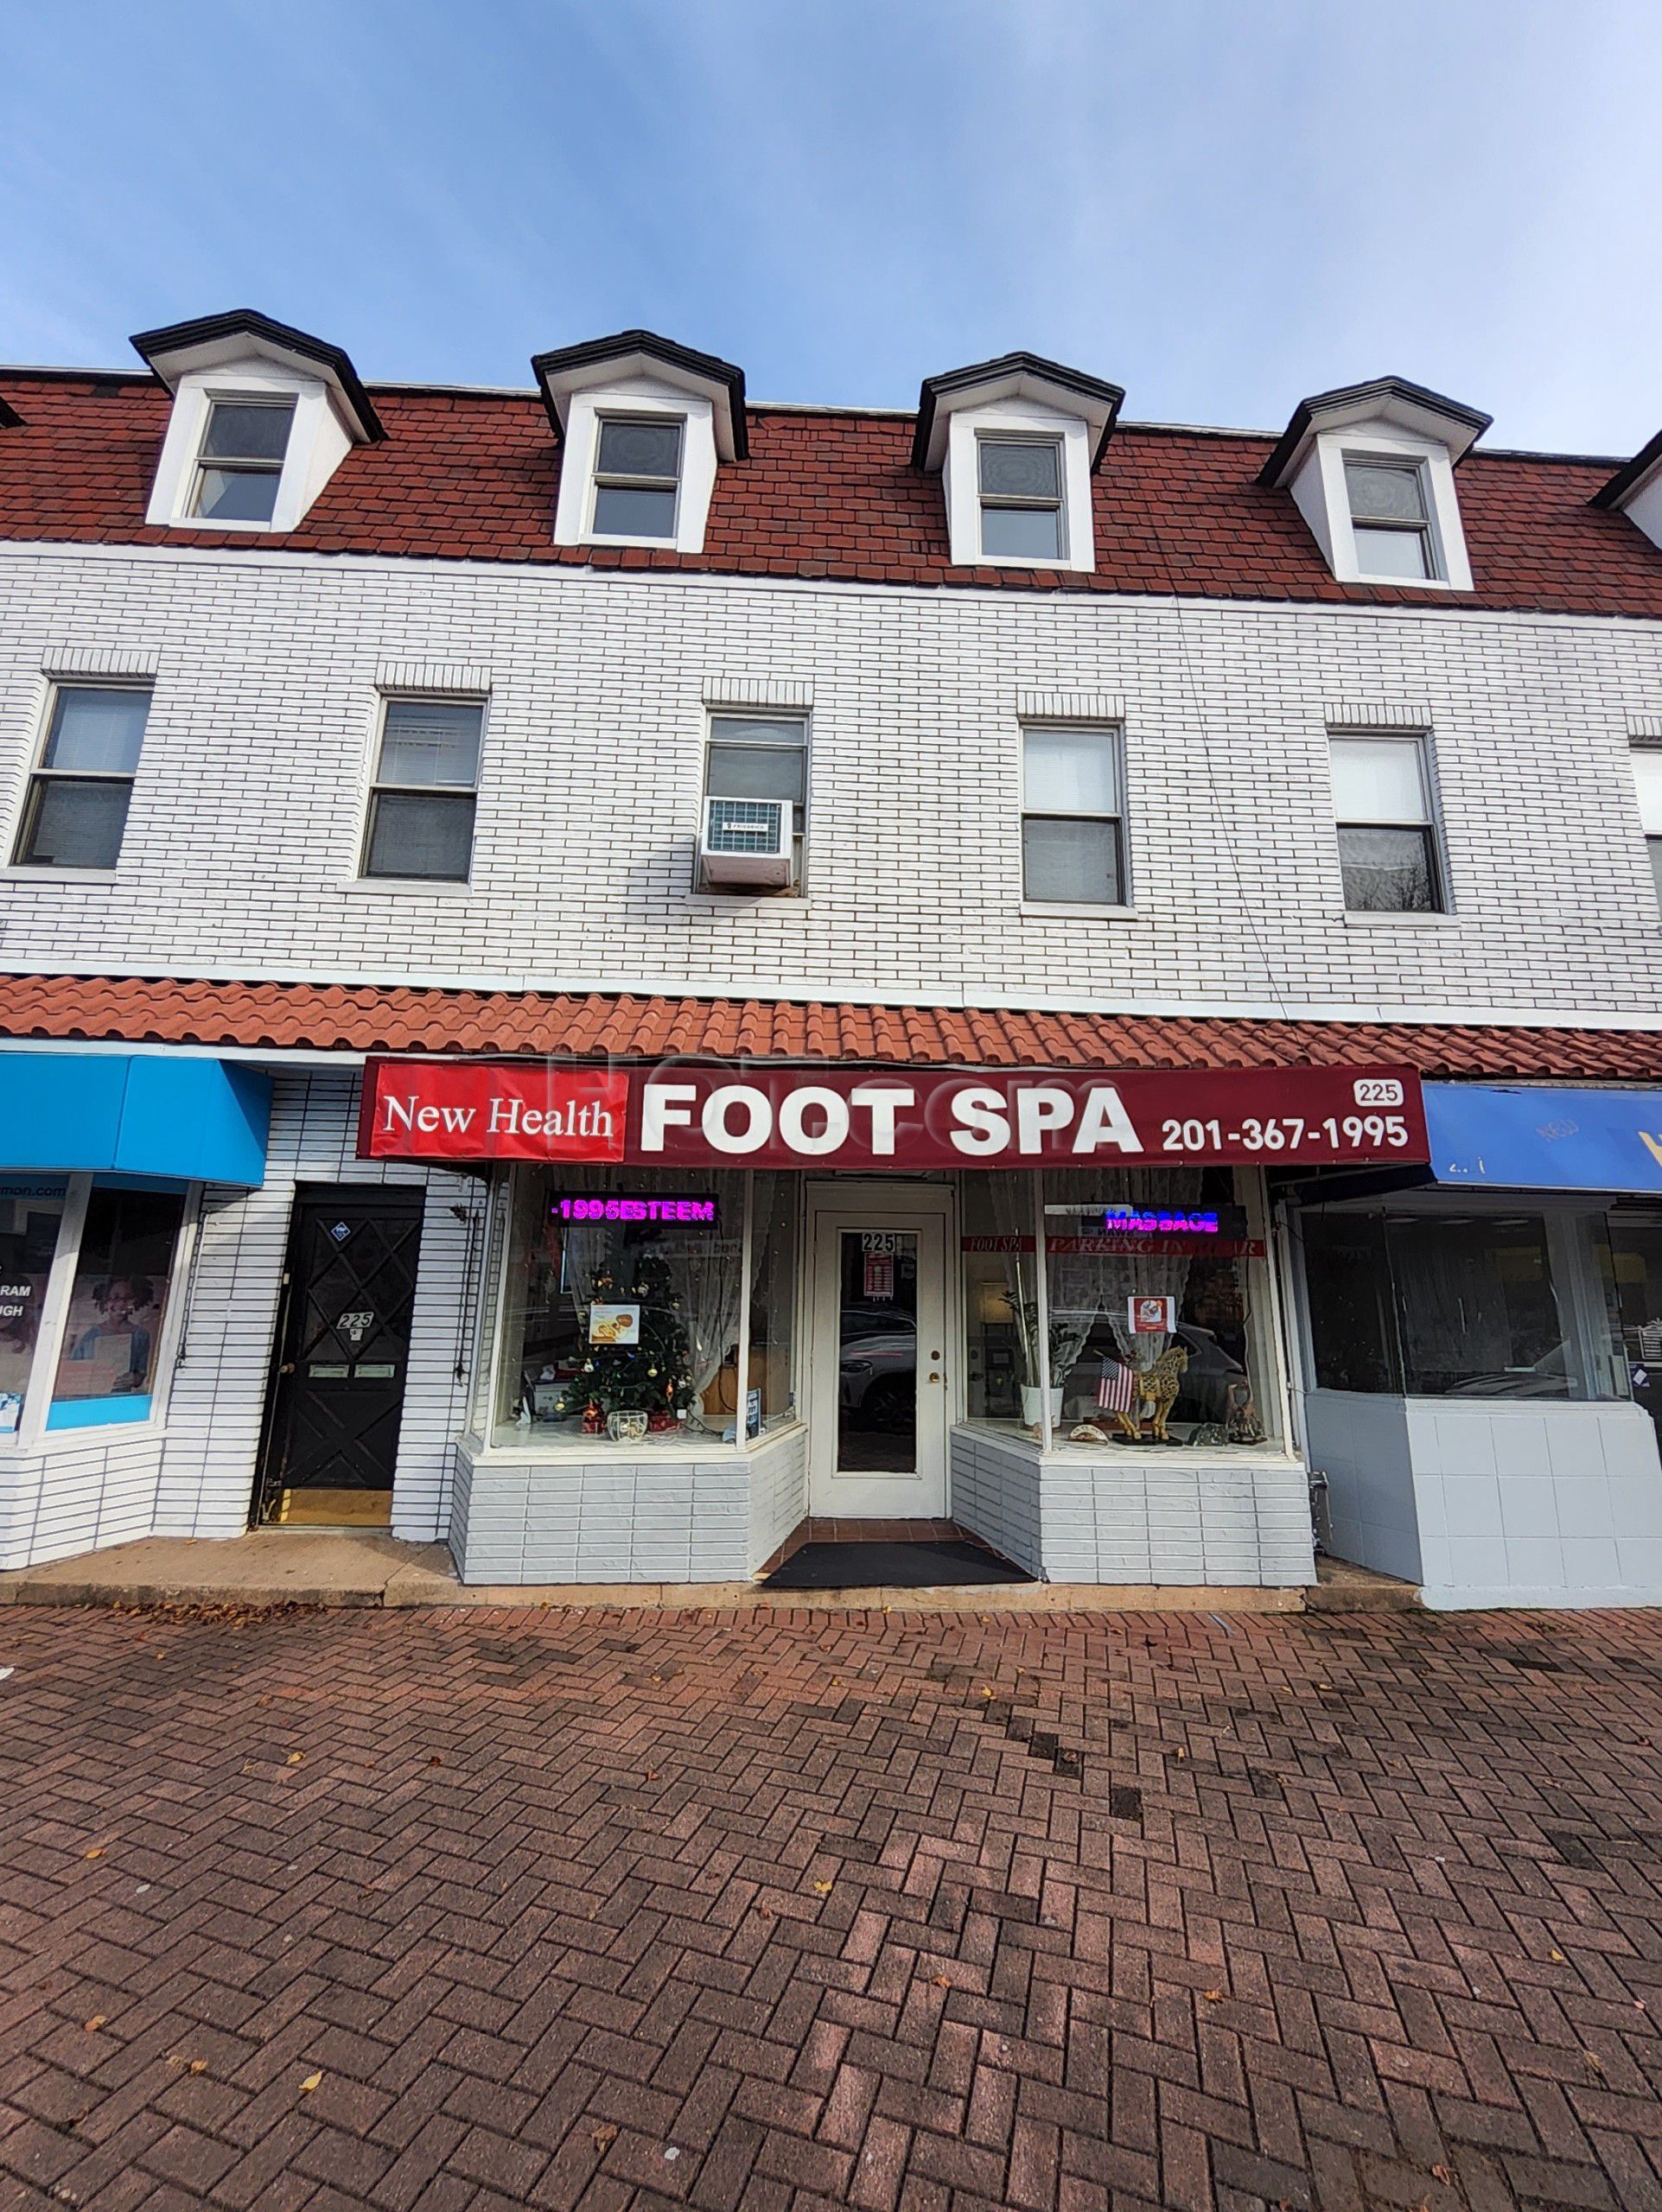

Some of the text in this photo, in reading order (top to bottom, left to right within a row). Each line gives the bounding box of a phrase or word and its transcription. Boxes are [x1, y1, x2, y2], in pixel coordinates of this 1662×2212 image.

[1360, 1084, 1398, 1102] 225
[381, 1095, 614, 1136] New Health
[640, 1084, 1144, 1156] FOOT SPA
[1162, 1116, 1409, 1151] 201-367-1995
[0, 1185, 67, 1198] mon.com
[863, 1233, 894, 1251] 225
[971, 1236, 1022, 1252] FOOT SPA
[1050, 1238, 1153, 1253] PARKING
[340, 1313, 373, 1327] 225
